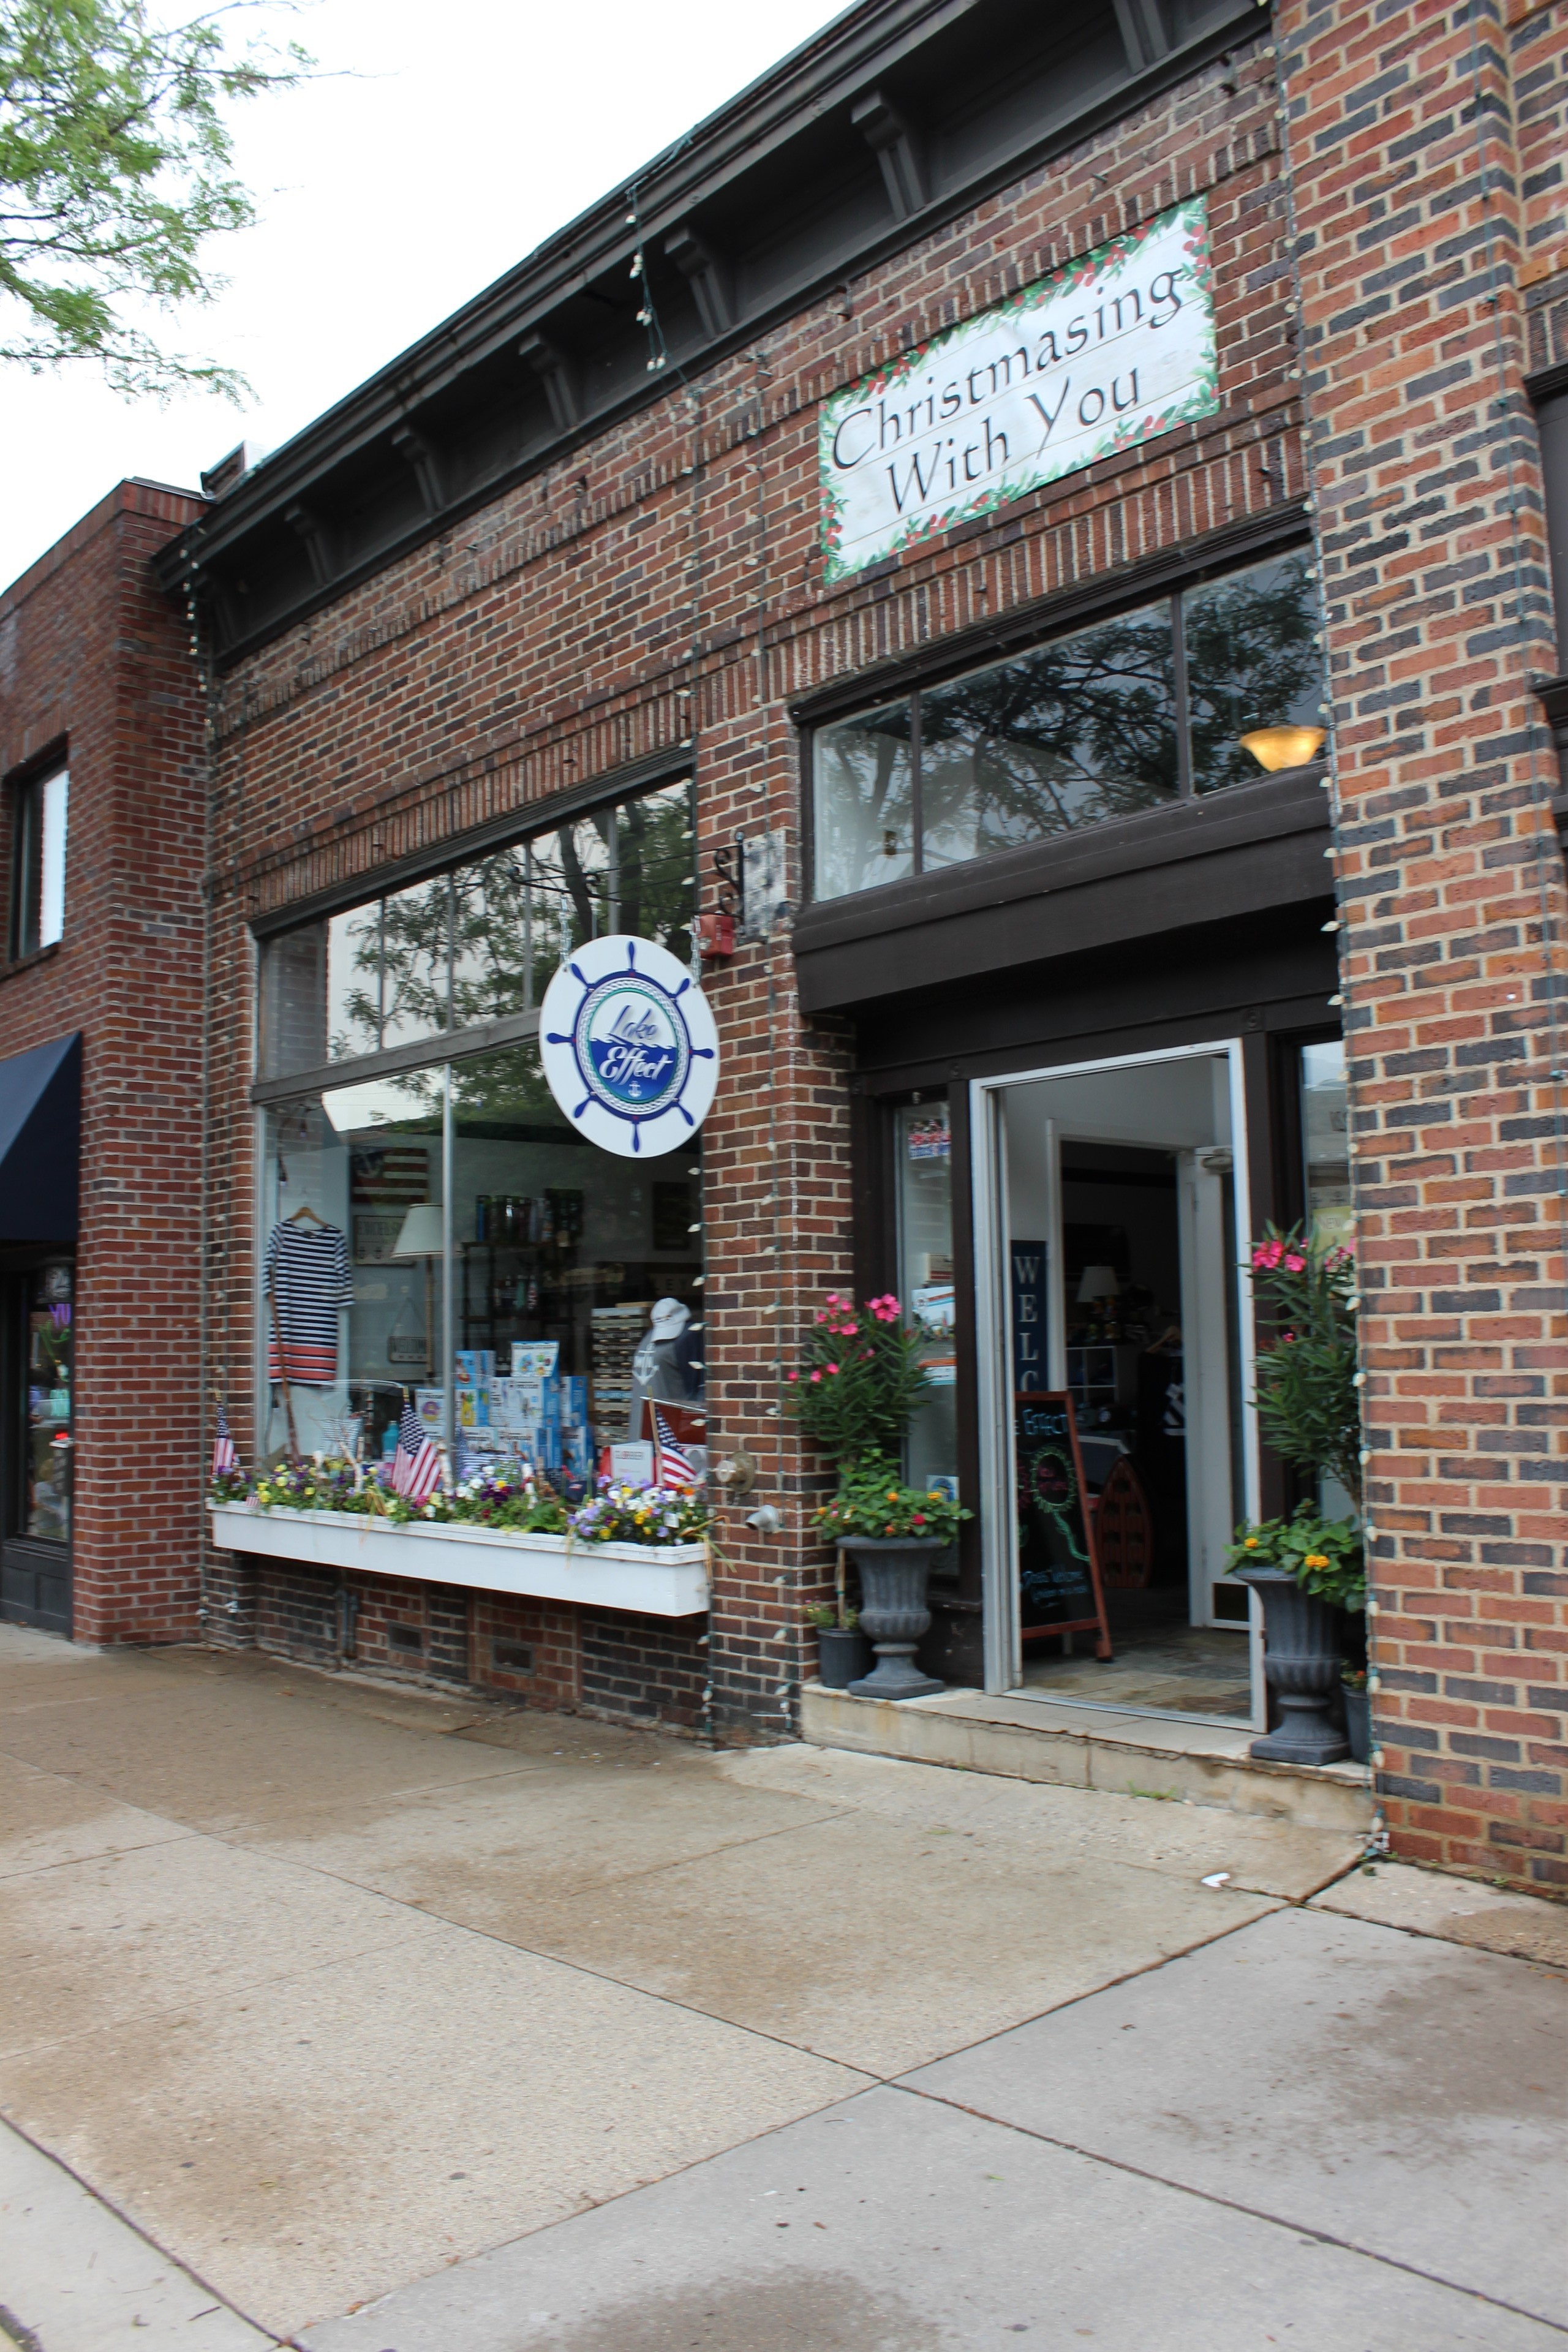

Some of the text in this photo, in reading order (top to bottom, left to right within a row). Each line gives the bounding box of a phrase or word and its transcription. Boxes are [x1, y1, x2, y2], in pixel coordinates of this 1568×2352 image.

[832, 268, 1183, 470] Christmasing
[886, 368, 1140, 514] With You
[599, 1046, 673, 1085] Effect
[608, 1005, 659, 1041] Lake
